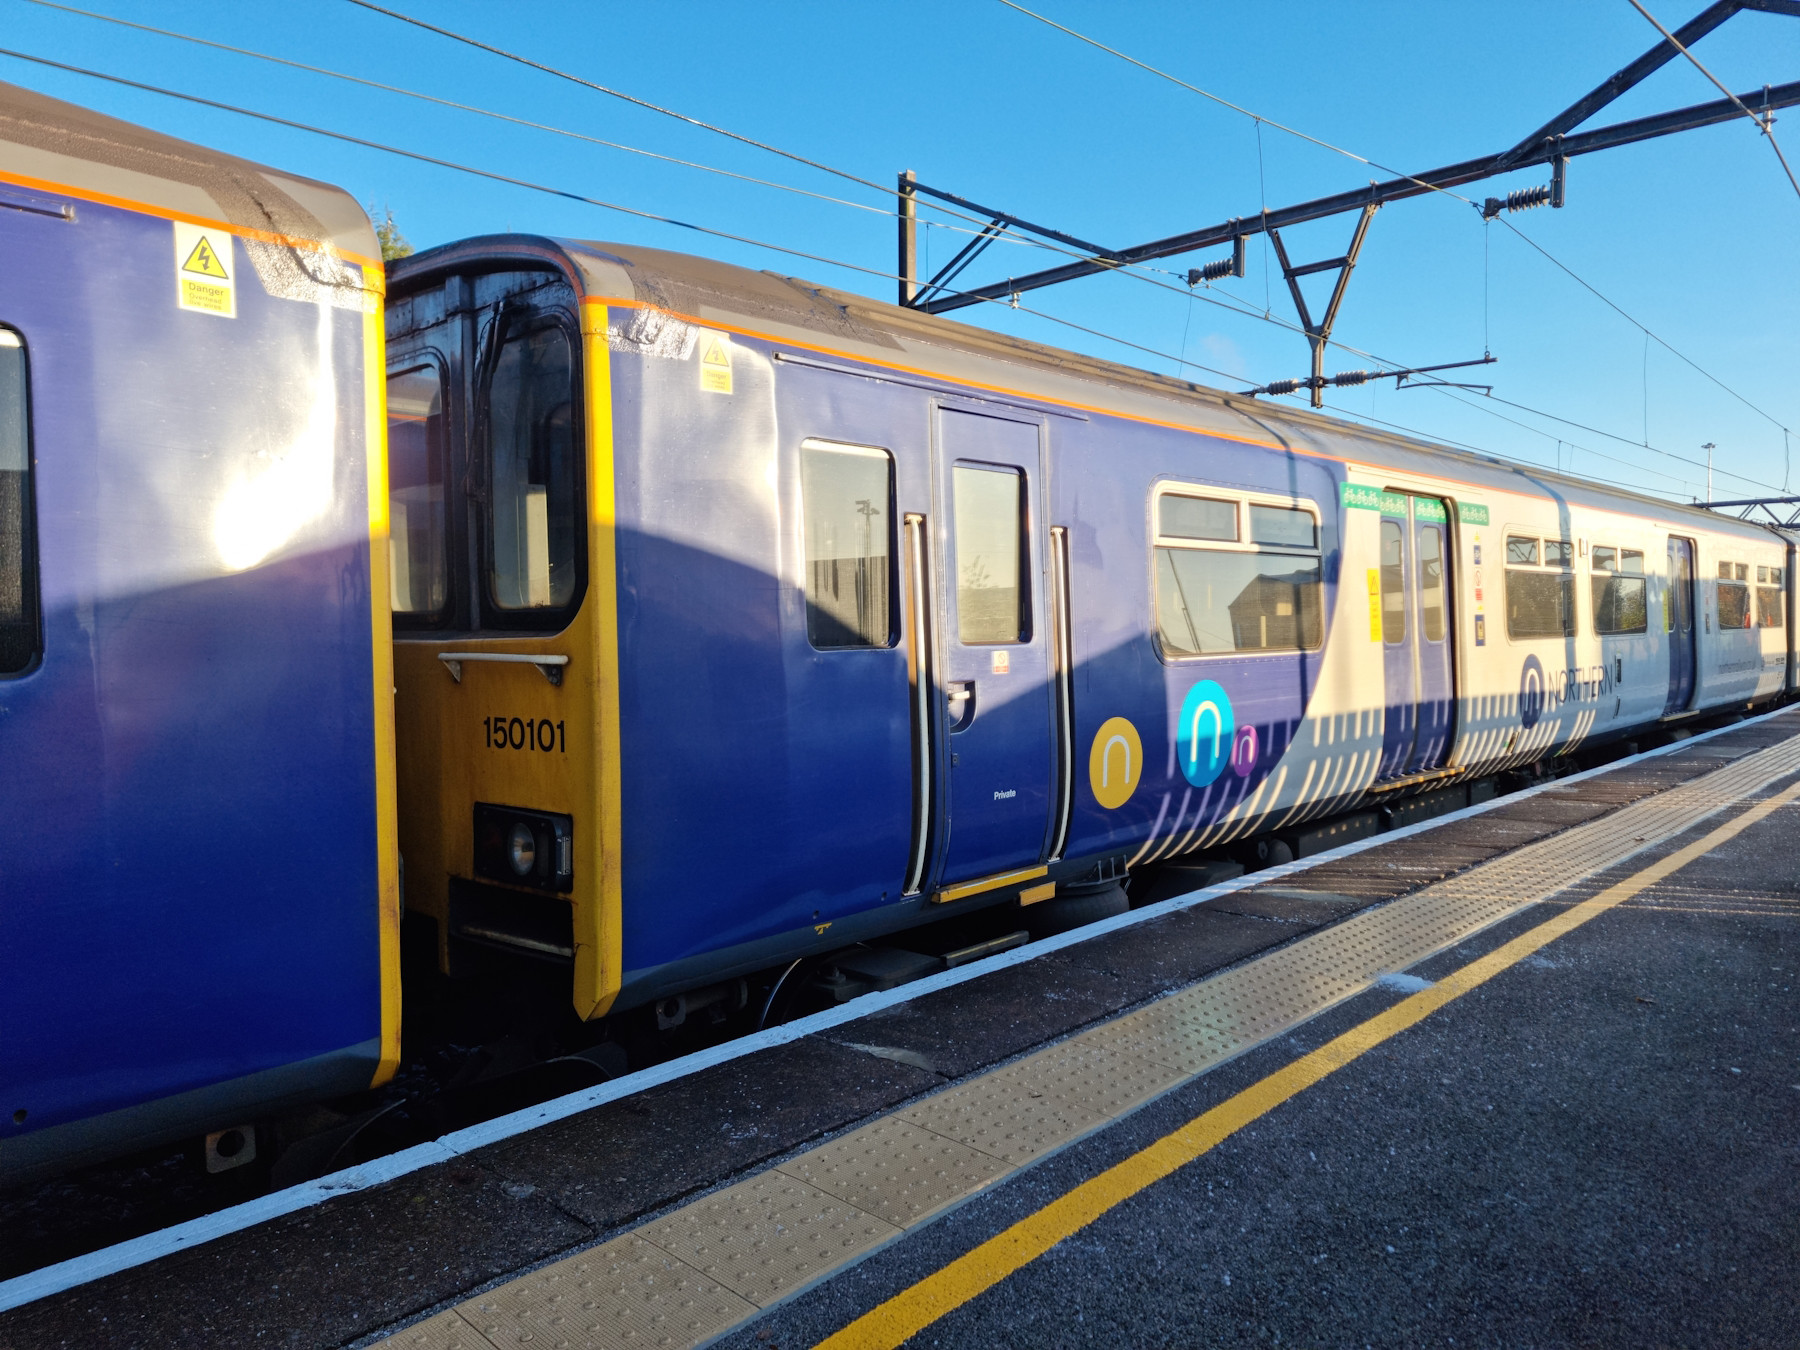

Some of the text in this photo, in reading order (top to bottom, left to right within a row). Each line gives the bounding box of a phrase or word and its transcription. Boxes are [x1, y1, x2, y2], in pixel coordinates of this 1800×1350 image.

[189, 282, 224, 296] Danger
[1548, 664, 1613, 706] NORTHERN
[483, 716, 565, 752] 150101
[993, 789, 1017, 800] Private
